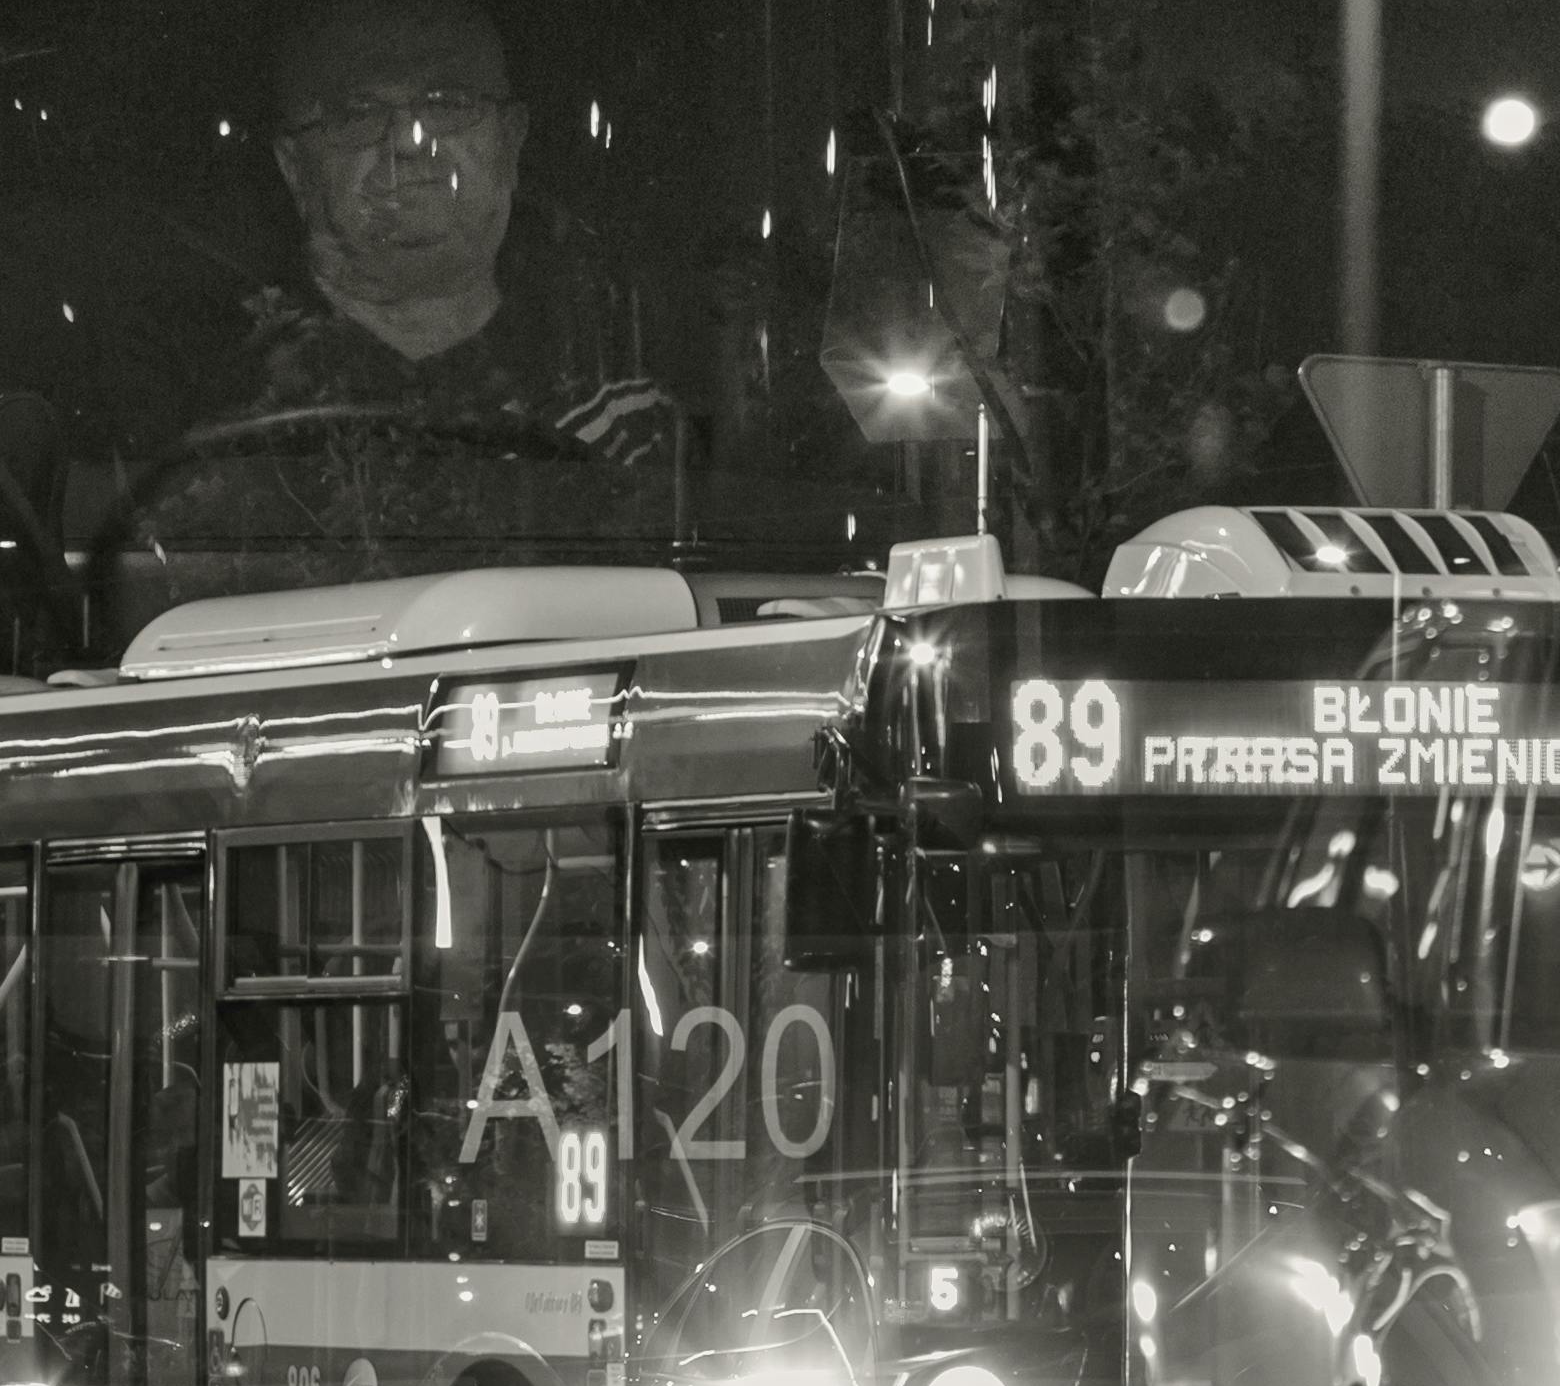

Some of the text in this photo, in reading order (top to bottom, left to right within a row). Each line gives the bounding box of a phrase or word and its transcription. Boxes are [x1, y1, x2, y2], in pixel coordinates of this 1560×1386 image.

[1012, 679, 1121, 787] 89
[1313, 684, 1500, 734] BŁONIE
[458, 1004, 837, 1164] A120
[558, 1132, 608, 1225] 89
[930, 1267, 959, 1311] 5
